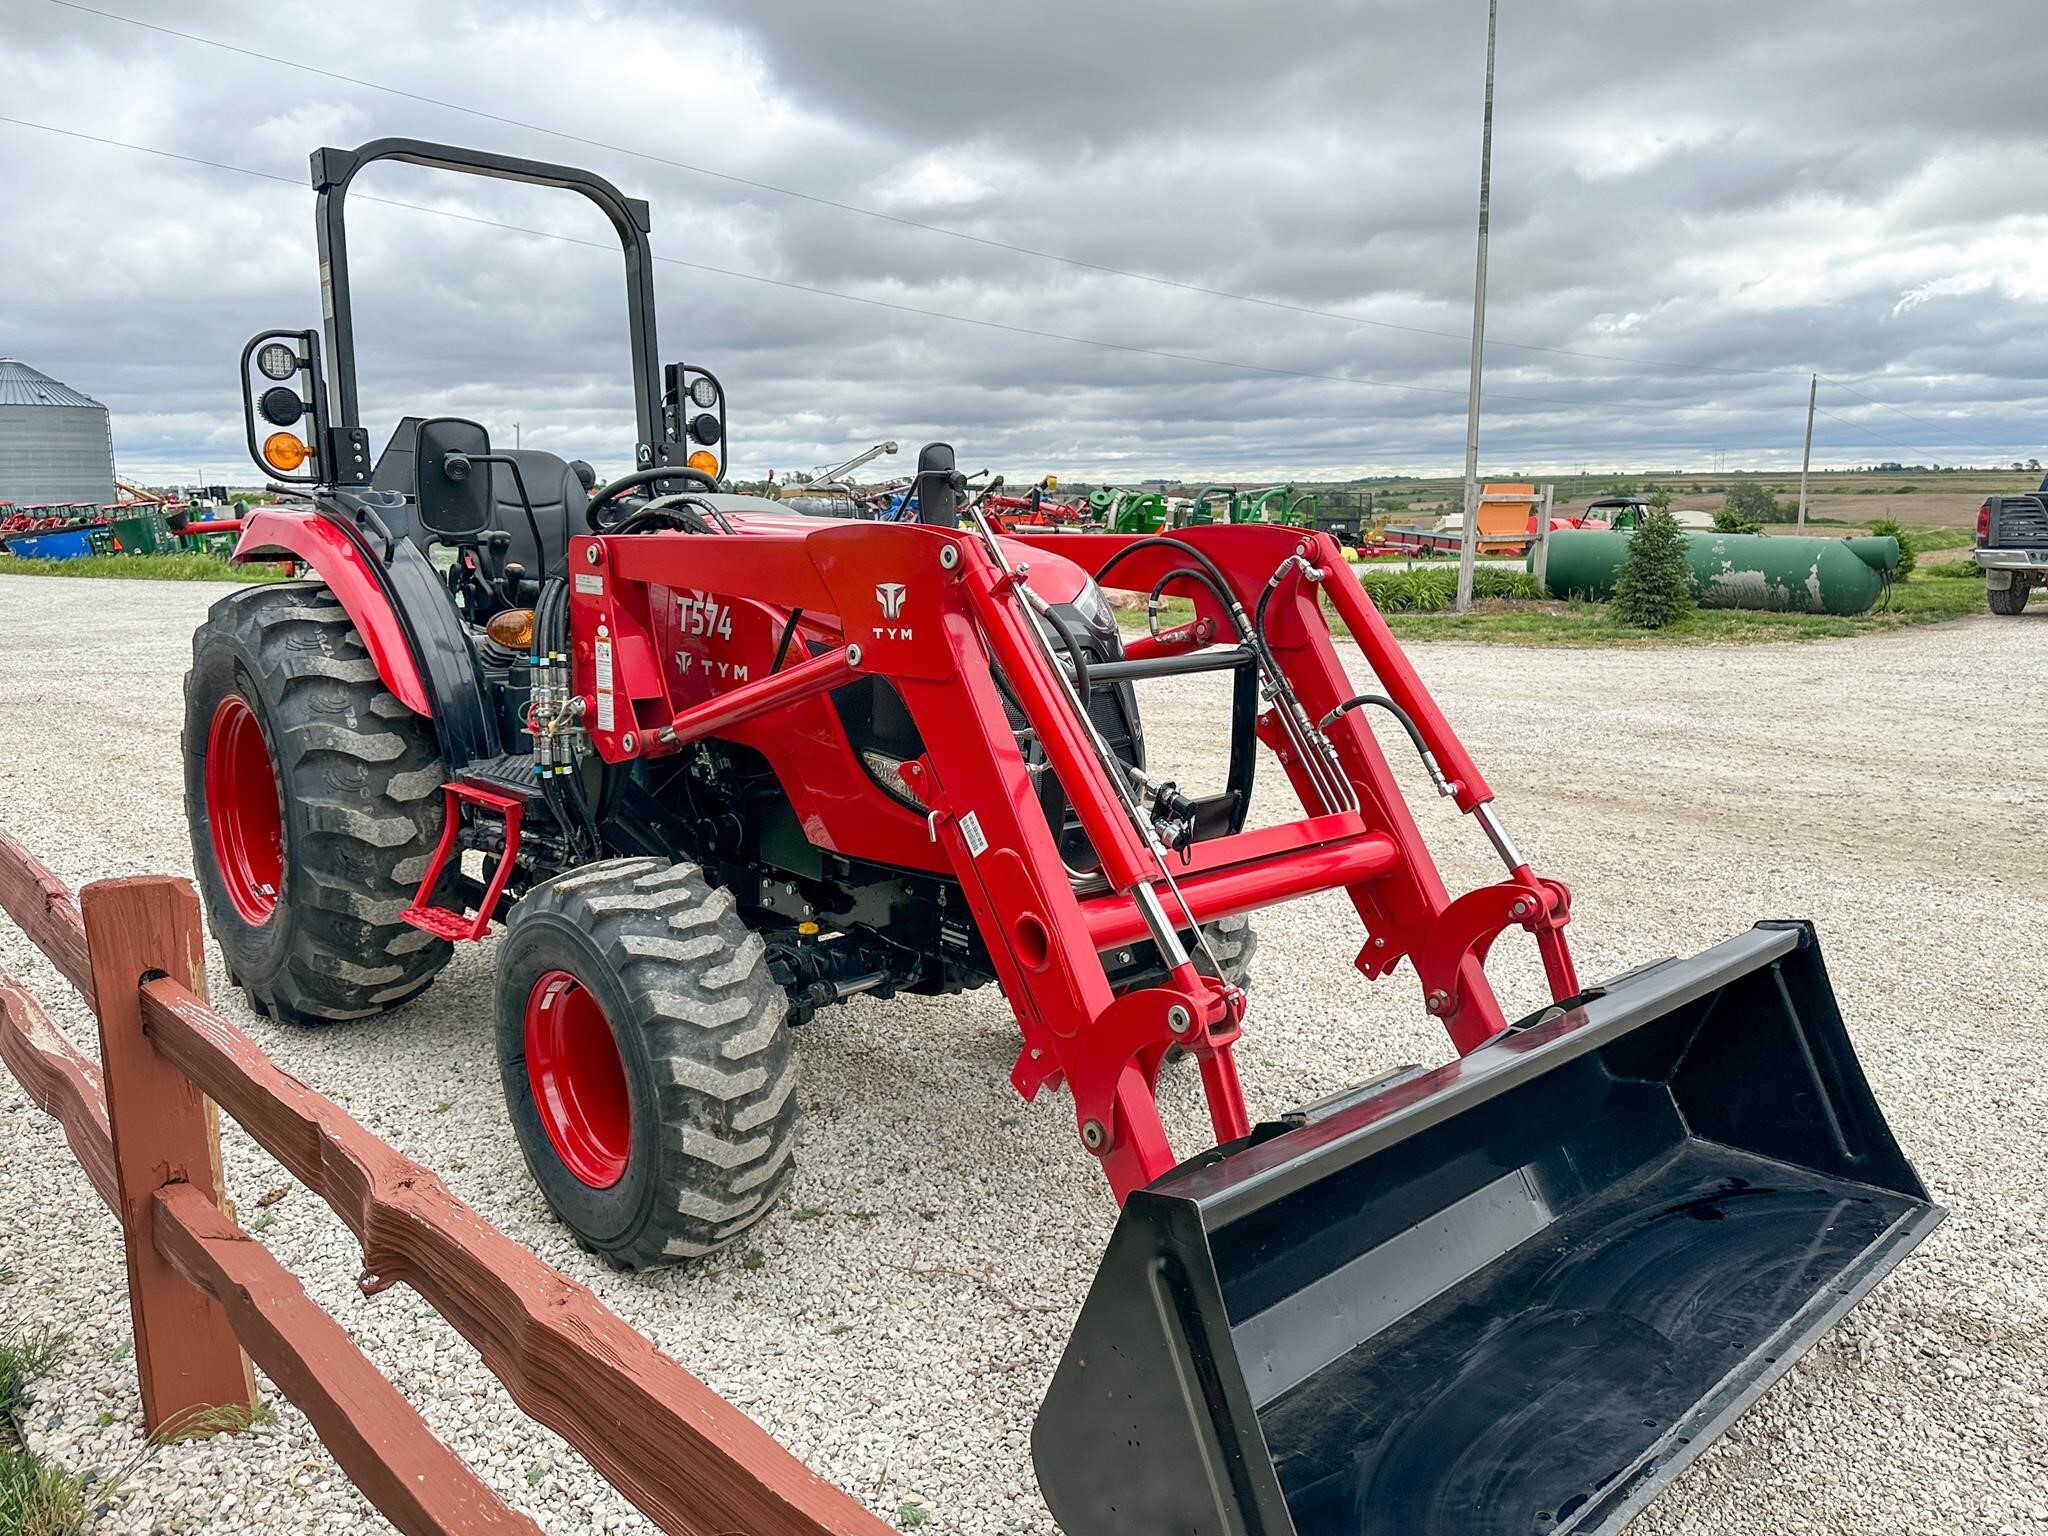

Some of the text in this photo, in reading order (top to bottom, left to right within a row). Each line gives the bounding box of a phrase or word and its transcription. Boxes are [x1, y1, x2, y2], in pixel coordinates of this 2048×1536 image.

[676, 596, 732, 641] T574
[872, 627, 913, 641] TYM
[700, 659, 748, 682] TYM
